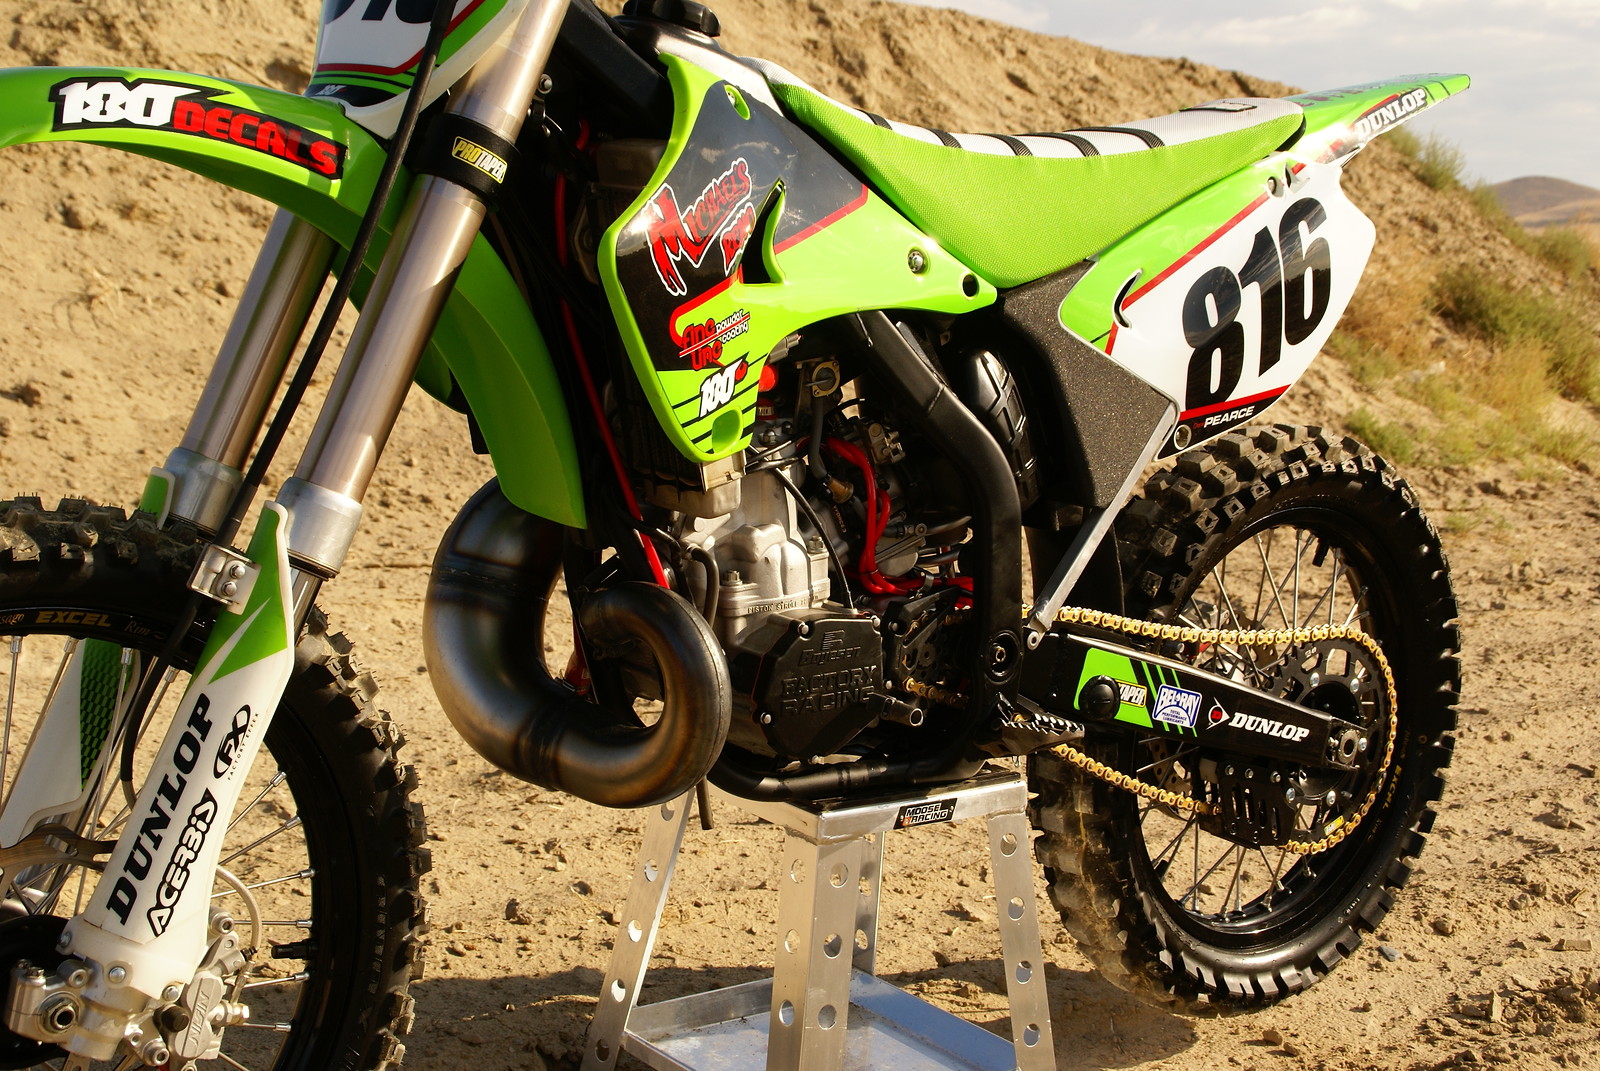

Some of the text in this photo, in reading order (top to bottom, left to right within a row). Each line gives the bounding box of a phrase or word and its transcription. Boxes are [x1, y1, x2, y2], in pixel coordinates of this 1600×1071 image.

[1355, 88, 1427, 141] DUNLOP
[173, 99, 337, 175] DECALS
[1182, 197, 1331, 411] 816
[1203, 405, 1256, 428] PEARCE
[35, 610, 112, 628] EXCEL
[747, 603, 774, 614] PISTON
[782, 665, 877, 695] FACTORY
[1119, 682, 1146, 706] TAPER
[782, 685, 876, 714] RACING
[1228, 711, 1310, 742] DUNLOP
[227, 742, 247, 781] FACTORY
[105, 692, 213, 926] DUNLOP
[906, 804, 940, 816] MOOSE
[911, 811, 947, 823] RACING
